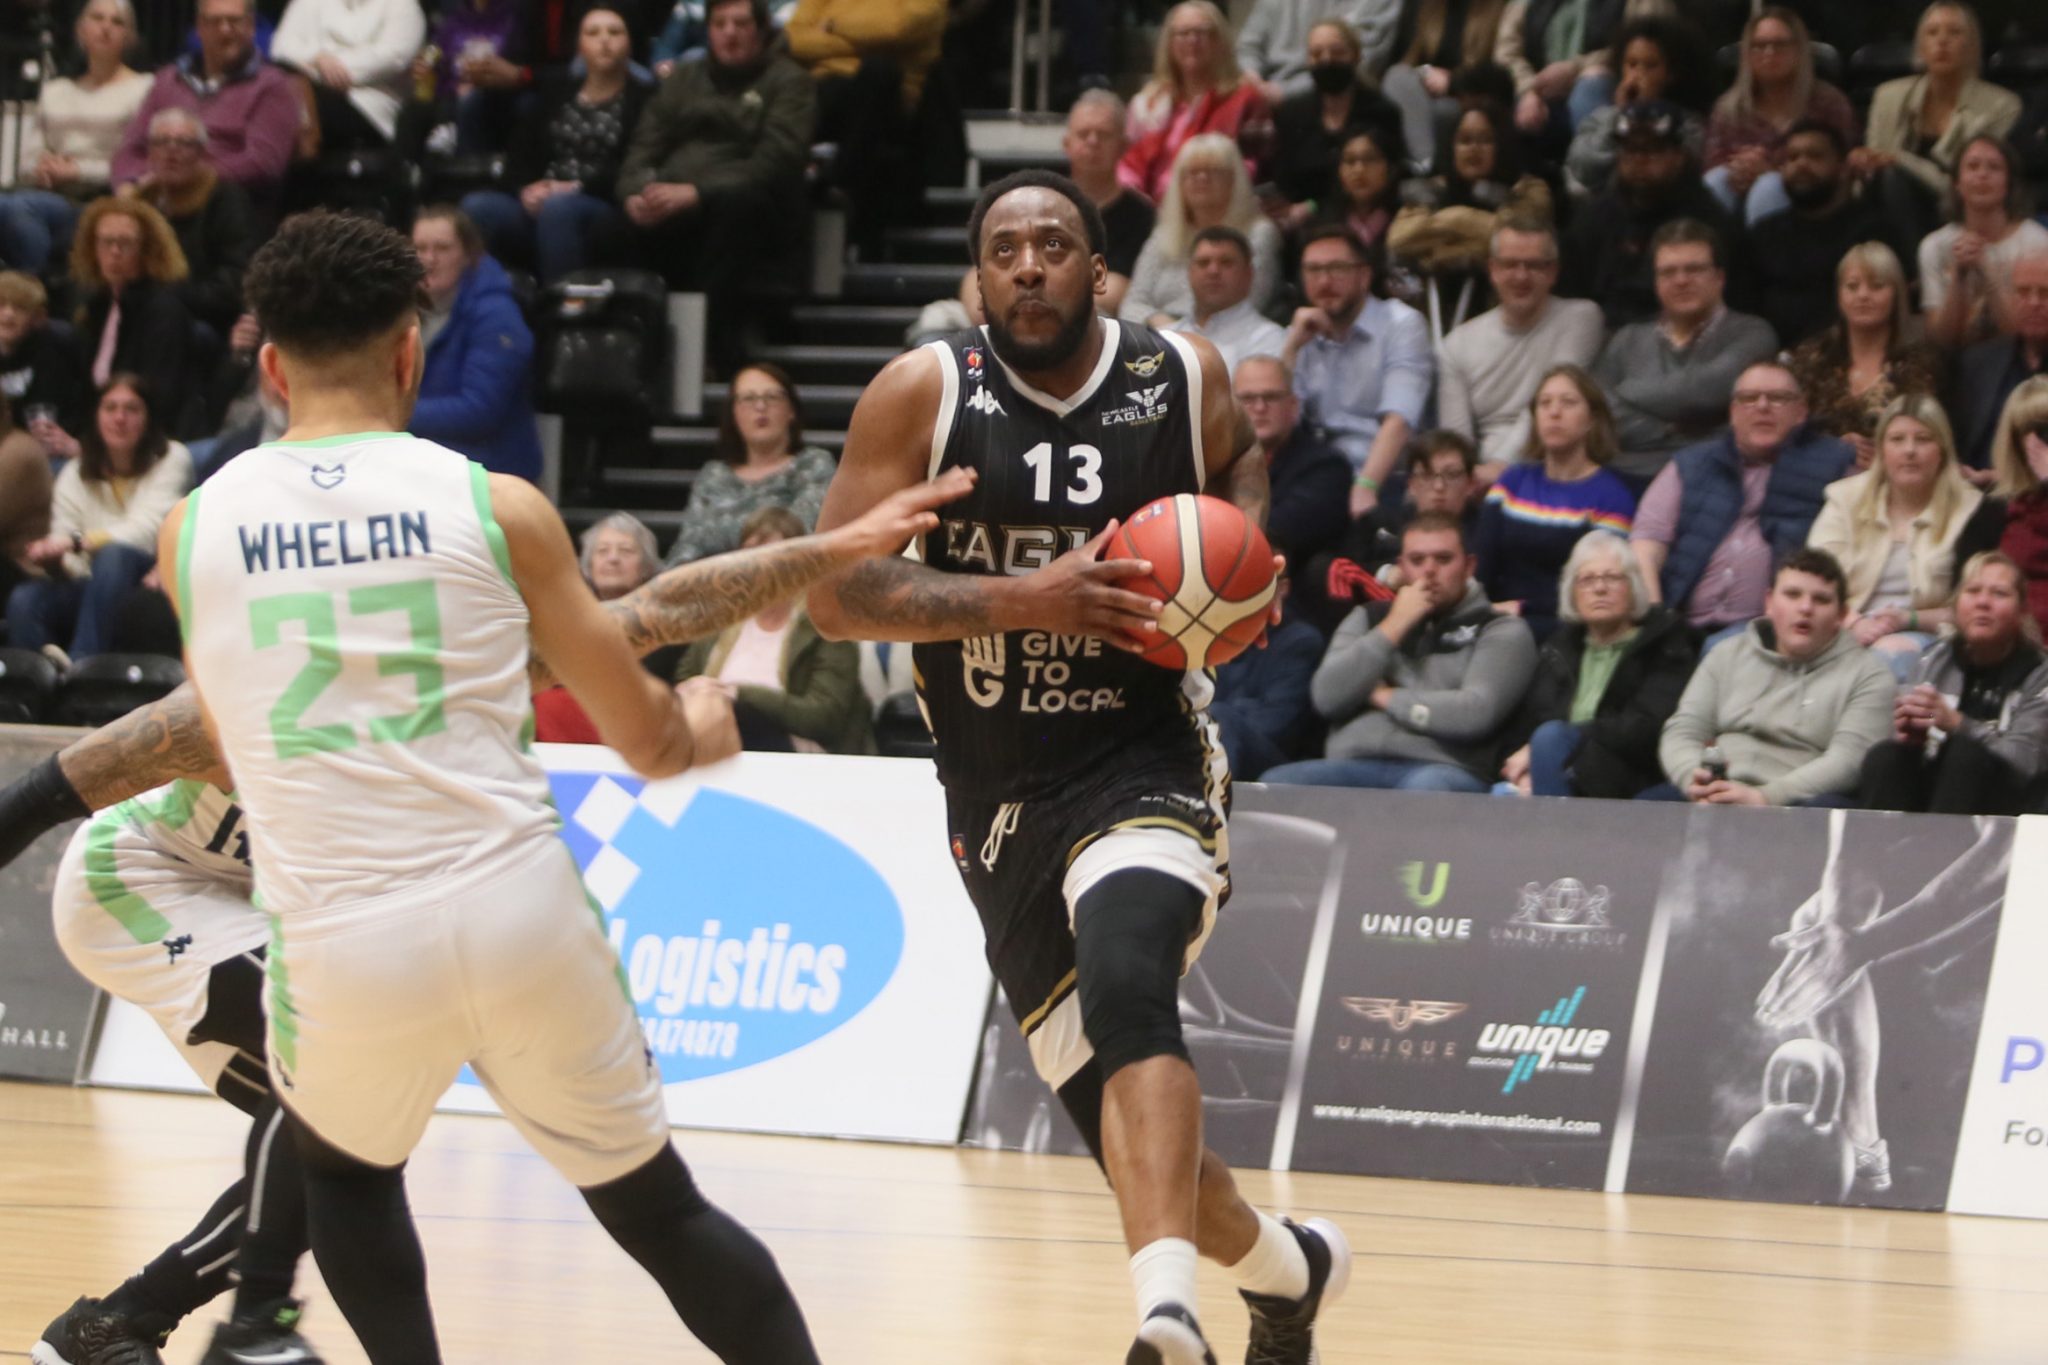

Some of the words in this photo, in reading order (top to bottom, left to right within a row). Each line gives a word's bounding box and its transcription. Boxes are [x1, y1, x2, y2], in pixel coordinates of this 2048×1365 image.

[1102, 403, 1168, 426] EAGLES
[1022, 441, 1103, 505] 13
[238, 511, 432, 574] WHELAN
[1020, 632, 1102, 658] GIVE
[247, 578, 448, 761] 23
[1020, 660, 1071, 685] TO
[1019, 687, 1127, 713] LOCAL
[1360, 912, 1473, 940] UNIQUE
[1, 1026, 69, 1050] HALL
[1336, 1034, 1457, 1057] UNIQUE
[1476, 1022, 1612, 1073] unique
[1311, 1102, 1602, 1136] www.uniquegroupinternational.com
[2004, 1119, 2048, 1147] Fo
